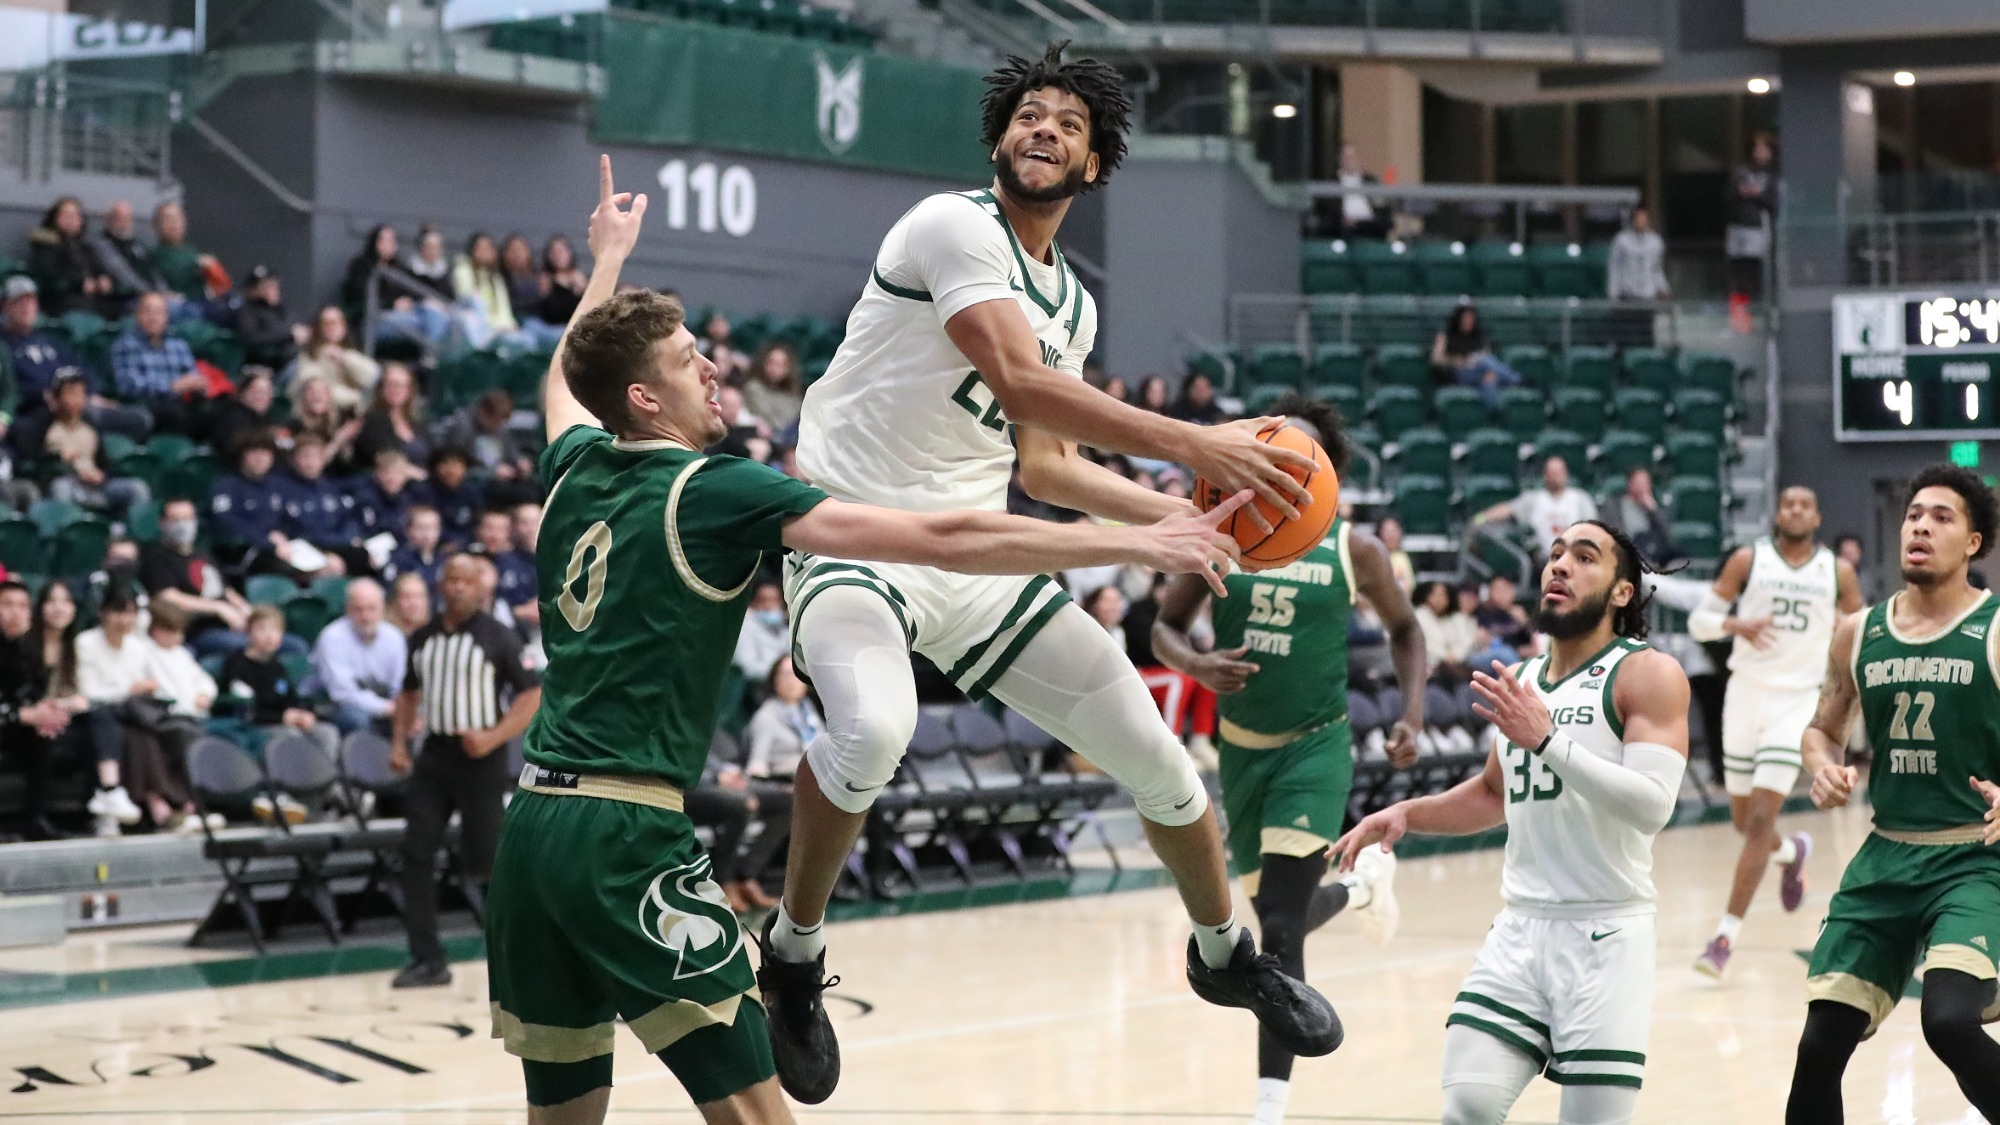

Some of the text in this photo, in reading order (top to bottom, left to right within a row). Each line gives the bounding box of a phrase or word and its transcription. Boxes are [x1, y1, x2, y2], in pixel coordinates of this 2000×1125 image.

[658, 159, 757, 237] 110
[1920, 297, 2000, 348] 15:4
[1883, 381, 1913, 425] 4
[1965, 383, 1979, 420] 1
[557, 520, 613, 632] 0
[1247, 582, 1299, 627] 55
[1771, 597, 1811, 632] 25
[1243, 628, 1293, 657] STATE
[1864, 656, 1975, 688] SACRAMENTO
[1889, 691, 1936, 741] 22
[1506, 742, 1563, 804] 33
[1889, 748, 1938, 775] STATE
